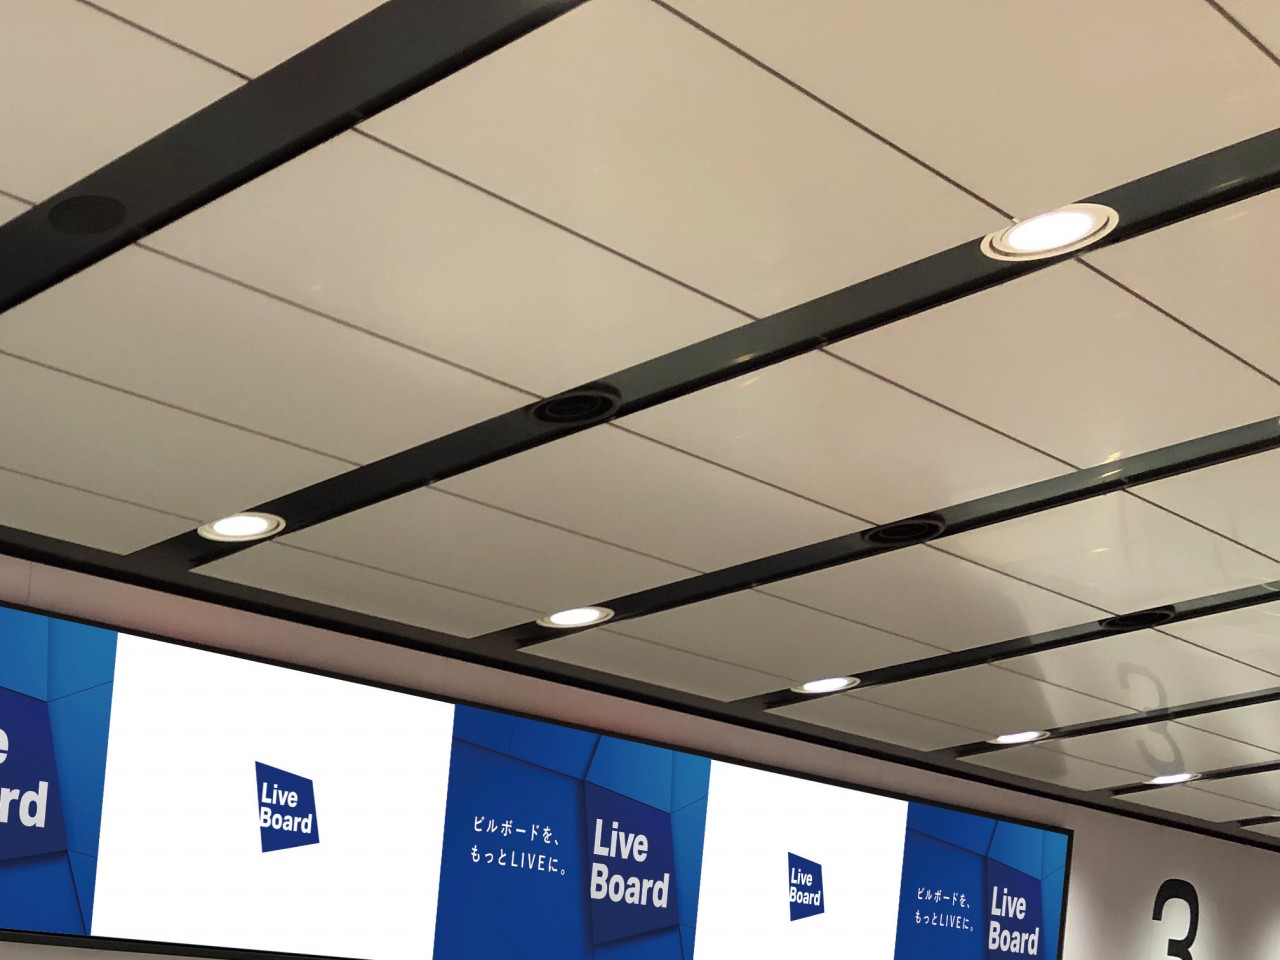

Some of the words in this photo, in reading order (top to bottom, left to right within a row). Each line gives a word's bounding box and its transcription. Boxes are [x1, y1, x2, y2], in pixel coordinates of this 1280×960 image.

[261, 783, 298, 808] Live
[259, 807, 313, 834] Board
[473, 815, 559, 847] ビルボードを、
[593, 818, 649, 862] Live
[470, 844, 566, 877] もっとLIVEに。
[590, 862, 670, 909] Board
[790, 867, 813, 887] Live
[789, 886, 821, 907] Board
[917, 887, 970, 909] ビルボードを、
[991, 886, 1026, 920] Live
[915, 911, 974, 932] もっとLIVEに。
[988, 920, 1039, 956] Board
